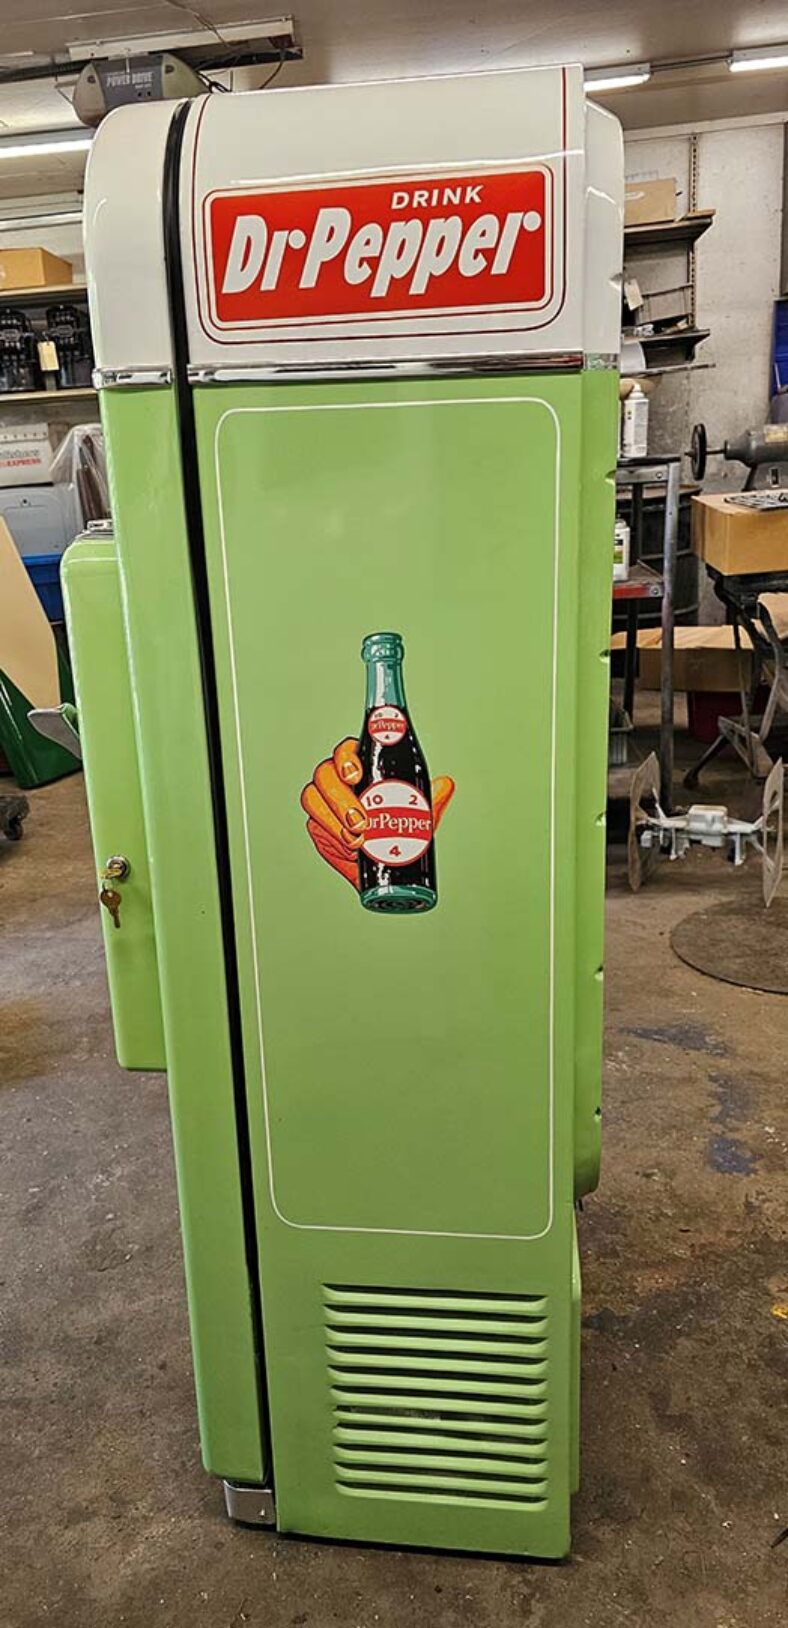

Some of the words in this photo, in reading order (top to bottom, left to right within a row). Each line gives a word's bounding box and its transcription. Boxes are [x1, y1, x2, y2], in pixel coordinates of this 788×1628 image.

[391, 185, 484, 209] DRINK
[366, 794, 384, 807] 10
[408, 794, 418, 805] 2
[389, 845, 401, 857] 4
